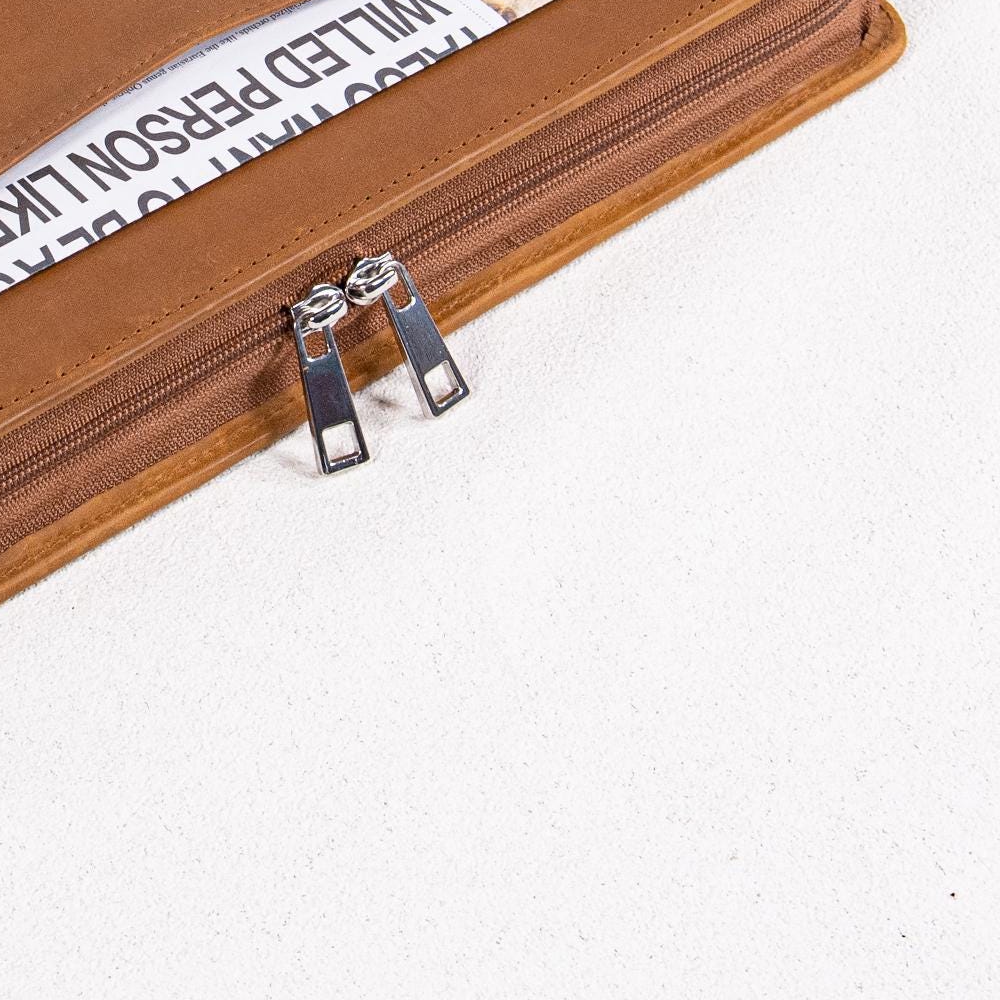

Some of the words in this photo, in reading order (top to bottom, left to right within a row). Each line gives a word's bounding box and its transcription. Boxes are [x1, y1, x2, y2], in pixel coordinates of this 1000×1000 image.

[205, 43, 220, 53] the
[220, 34, 238, 46] like
[168, 50, 206, 71] Eurasian
[142, 68, 167, 84] genus
[66, 67, 283, 192] PERSON
